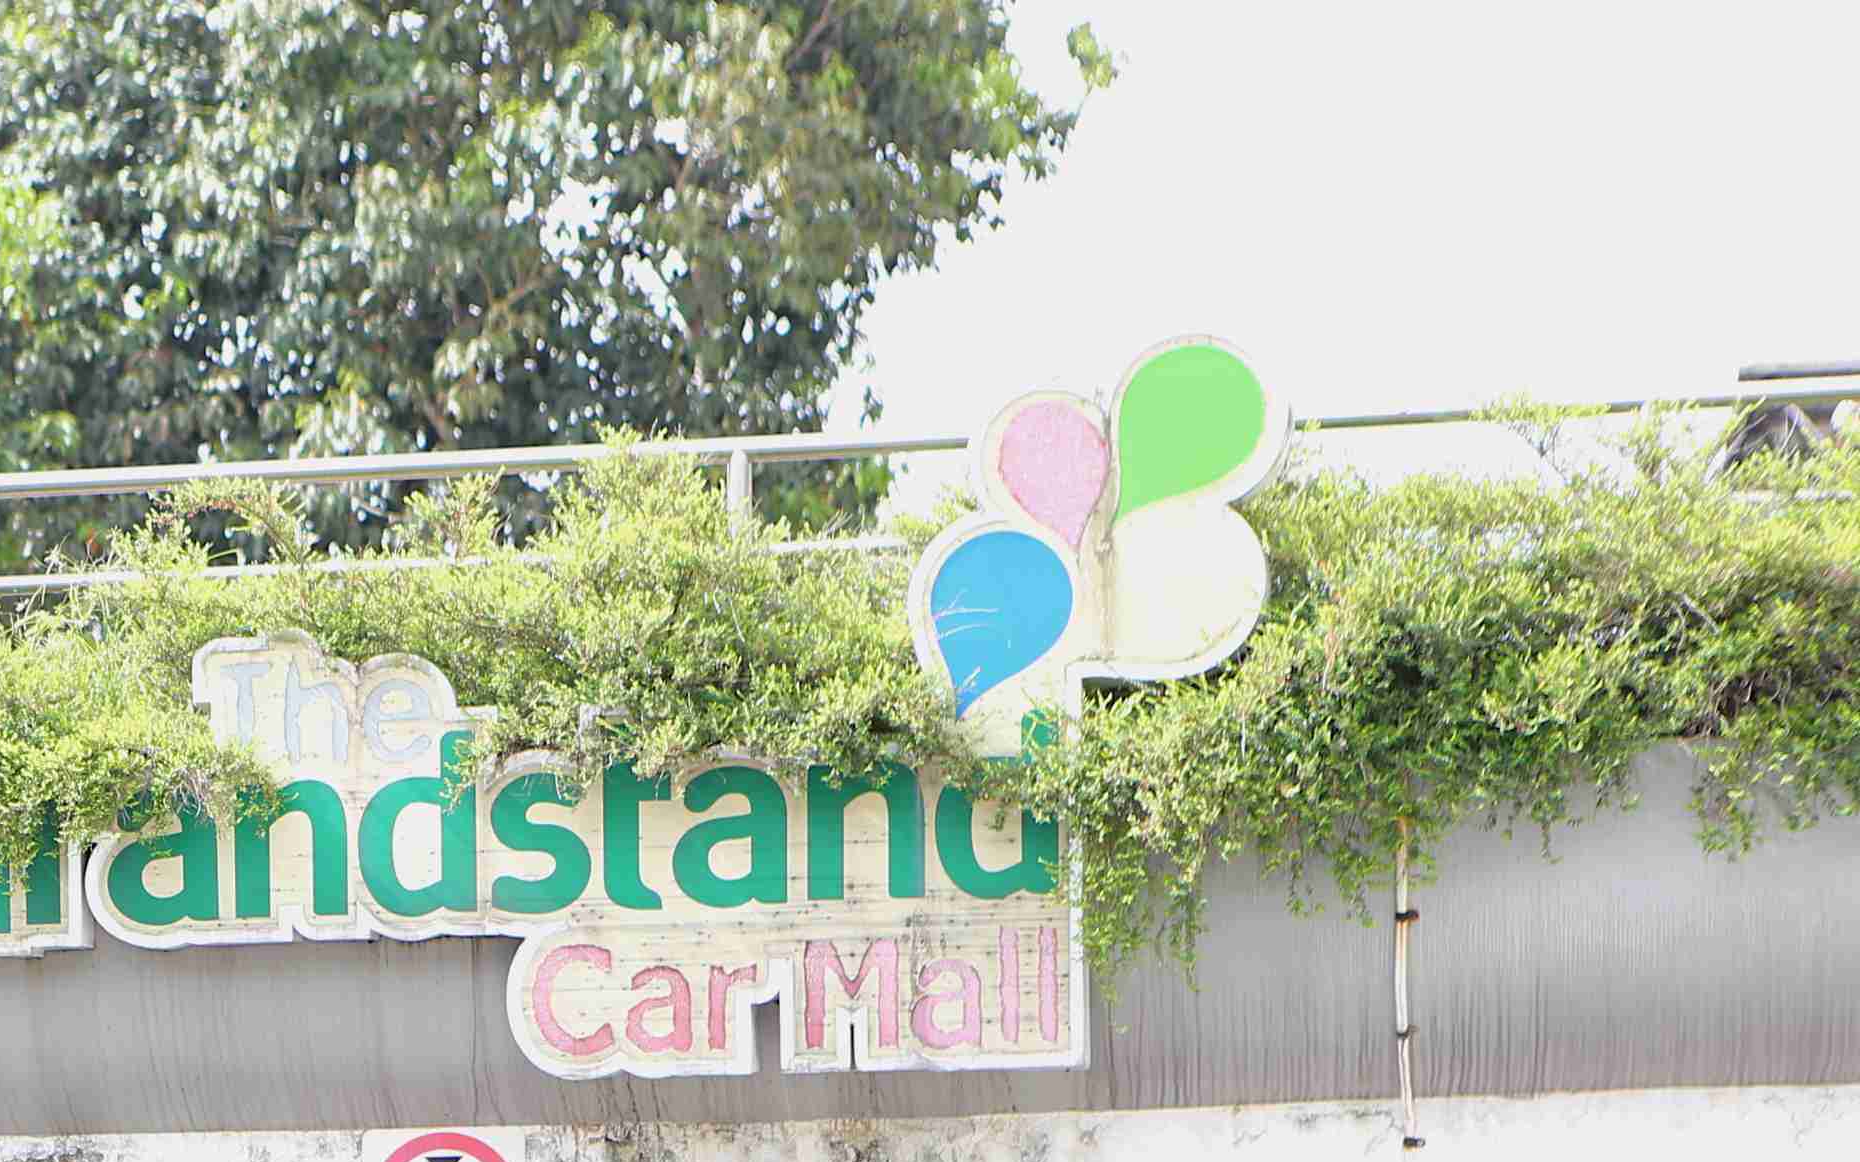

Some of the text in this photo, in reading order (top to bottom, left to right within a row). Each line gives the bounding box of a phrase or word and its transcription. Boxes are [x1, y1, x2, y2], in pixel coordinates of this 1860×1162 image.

[220, 662, 433, 763] The
[531, 926, 1059, 1057] Car Mall
